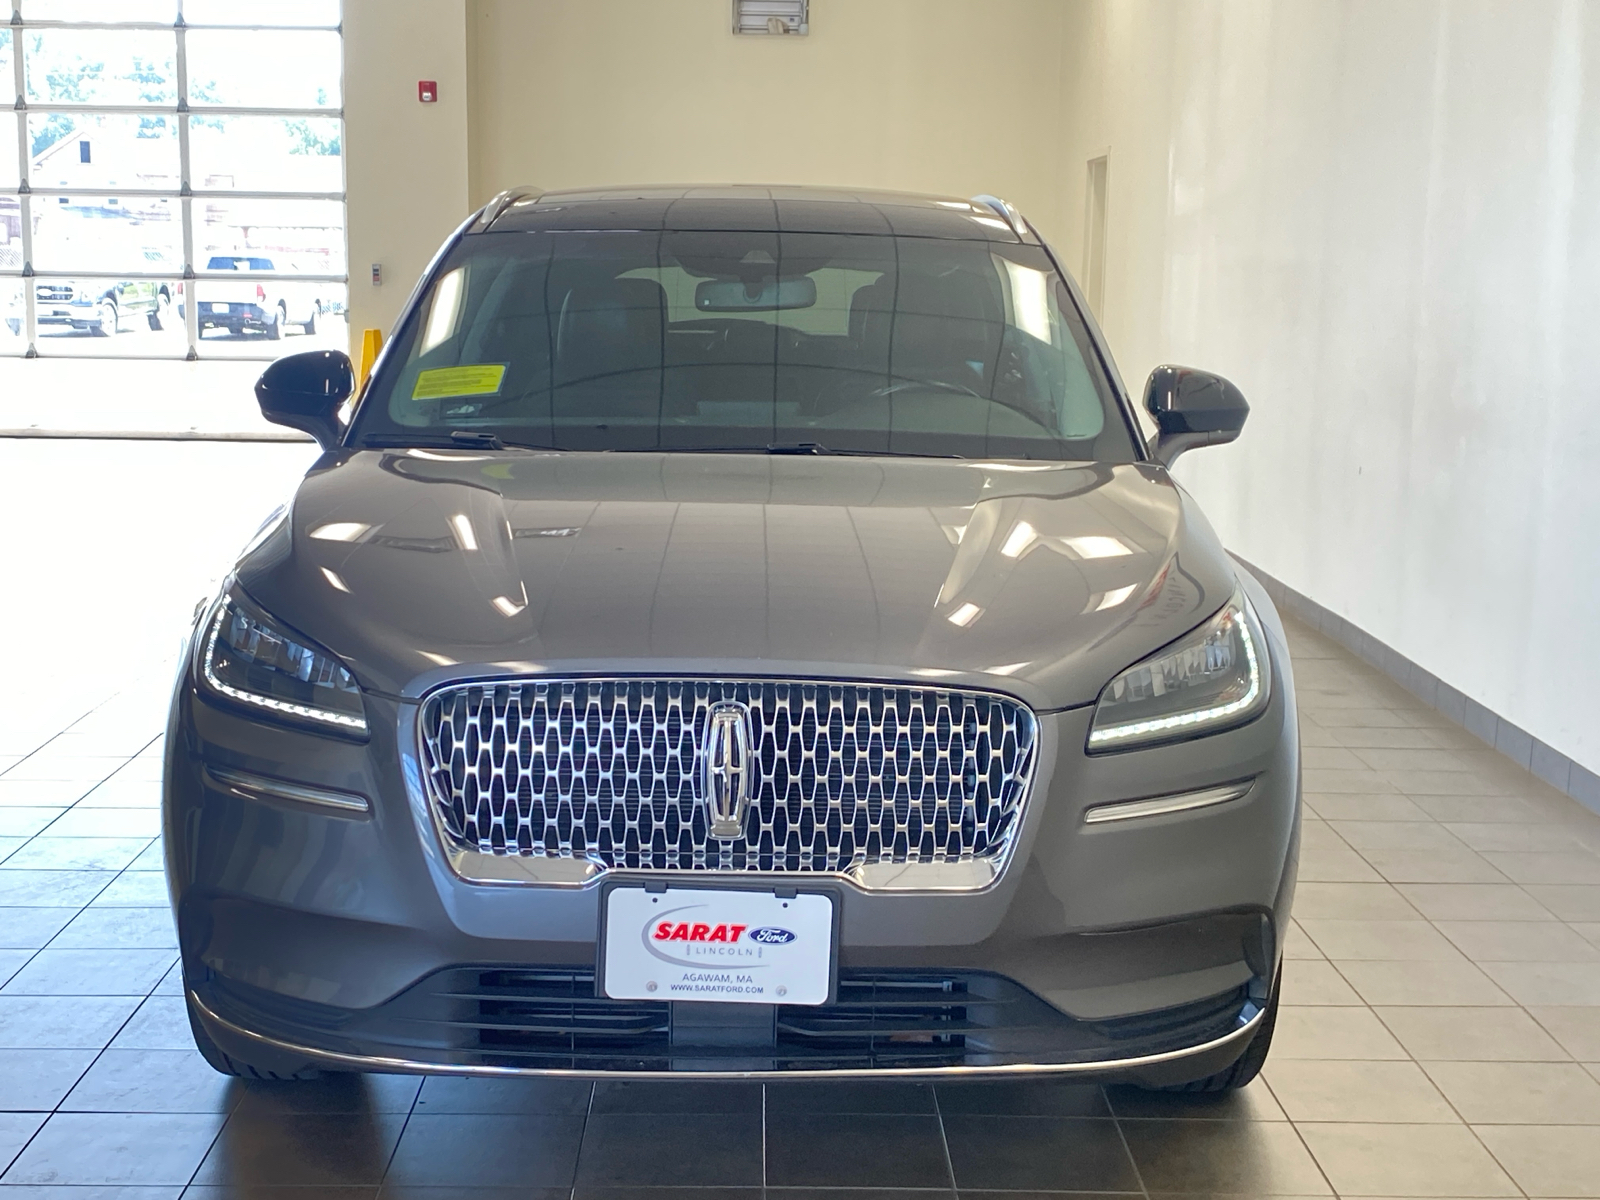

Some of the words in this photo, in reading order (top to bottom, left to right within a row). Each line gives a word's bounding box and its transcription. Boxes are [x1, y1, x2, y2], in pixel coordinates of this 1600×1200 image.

[653, 921, 748, 943] SARAT
[756, 928, 788, 943] Ford
[696, 946, 753, 956] LINCOLN
[682, 973, 734, 984] AGAWAM,
[736, 974, 753, 984] MA
[670, 984, 764, 994] WWW.SARATFORD.COM
